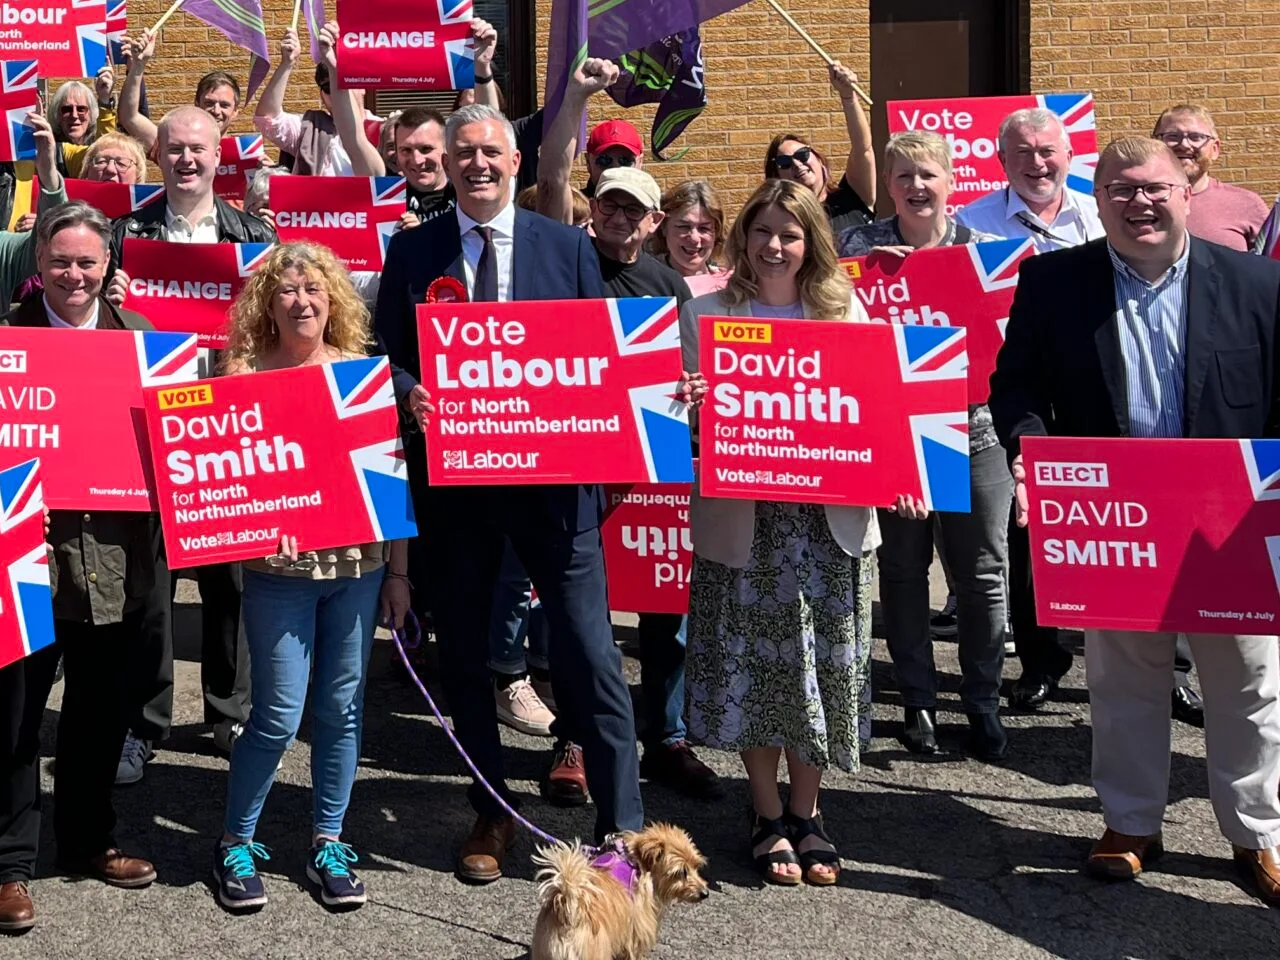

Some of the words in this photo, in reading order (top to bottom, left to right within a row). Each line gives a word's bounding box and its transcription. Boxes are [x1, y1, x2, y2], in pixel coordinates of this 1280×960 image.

[343, 31, 435, 49] CHANGE
[899, 108, 973, 131] Vote
[275, 212, 367, 229] CHANGE
[129, 278, 231, 300] CHANGE
[858, 277, 911, 306] vid
[431, 316, 526, 347] Vote
[719, 325, 765, 340] VOTE
[434, 350, 609, 389] Labour
[713, 347, 821, 379] David
[163, 389, 207, 406] VOTE
[438, 397, 466, 414] for
[471, 396, 530, 414] North
[713, 381, 860, 424] Smith
[161, 402, 263, 444] David
[440, 415, 620, 436] Northumberland
[714, 423, 739, 438] for
[743, 424, 795, 441] North
[166, 435, 306, 485] Smith
[463, 449, 539, 469] Labour
[714, 441, 872, 464] Northumberland
[715, 467, 756, 484] Vote
[769, 471, 823, 488] Labour
[1038, 466, 1104, 482] ELECT
[88, 487, 126, 497] Thursday
[133, 488, 150, 499] July
[172, 492, 195, 507] for
[199, 484, 248, 503] North
[175, 490, 322, 524] Northumberland
[1040, 499, 1148, 528] DAVID
[179, 536, 218, 552] Vote
[229, 526, 279, 545] Labour
[1043, 538, 1158, 568] SMITH
[1198, 609, 1245, 621] Thursday
[1253, 611, 1275, 622] July
